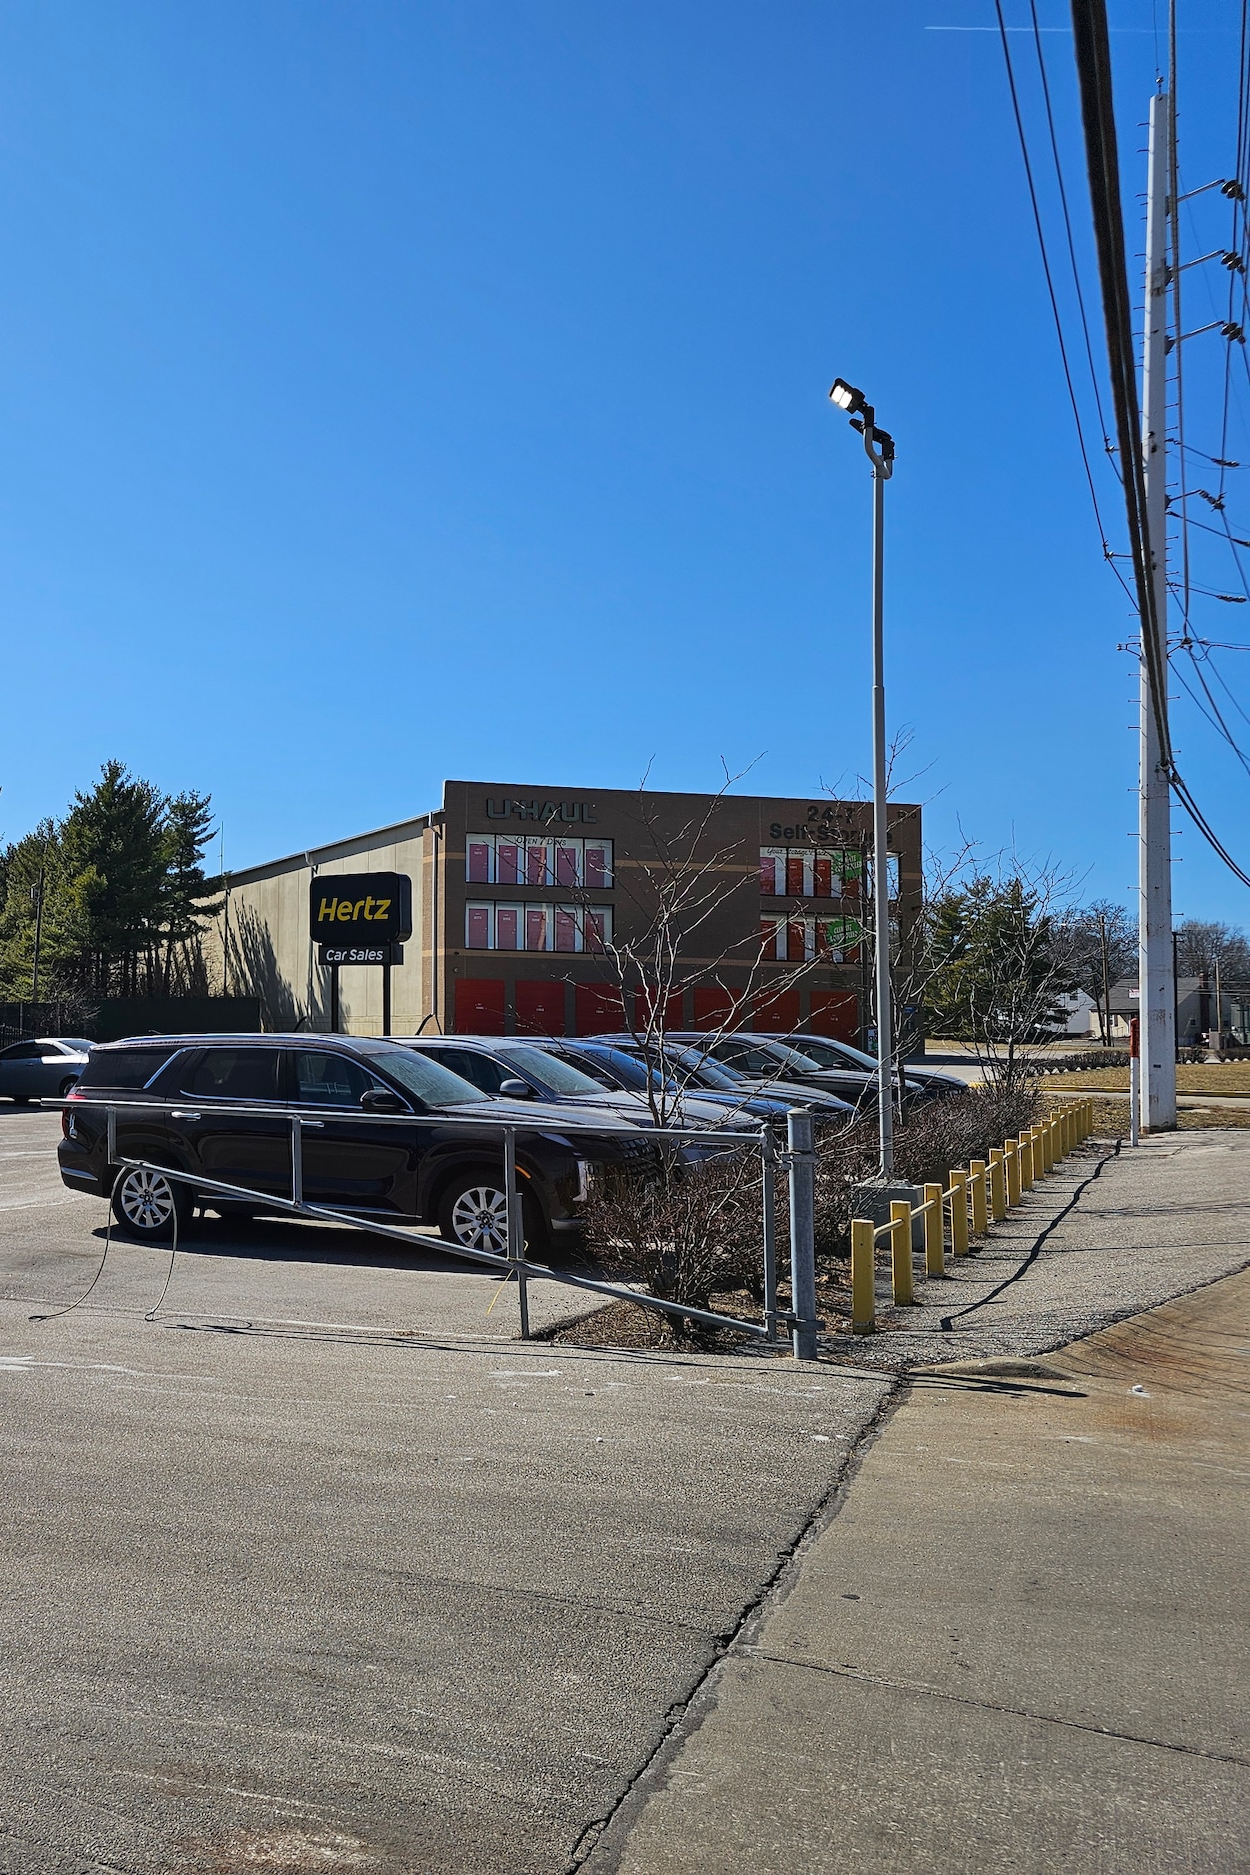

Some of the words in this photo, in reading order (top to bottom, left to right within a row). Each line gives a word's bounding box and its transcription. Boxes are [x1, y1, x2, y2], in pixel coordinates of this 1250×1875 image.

[486, 799, 597, 823] U-HAUL
[317, 896, 391, 921] Hertz
[326, 949, 347, 961] Car
[349, 948, 384, 961] Sales
